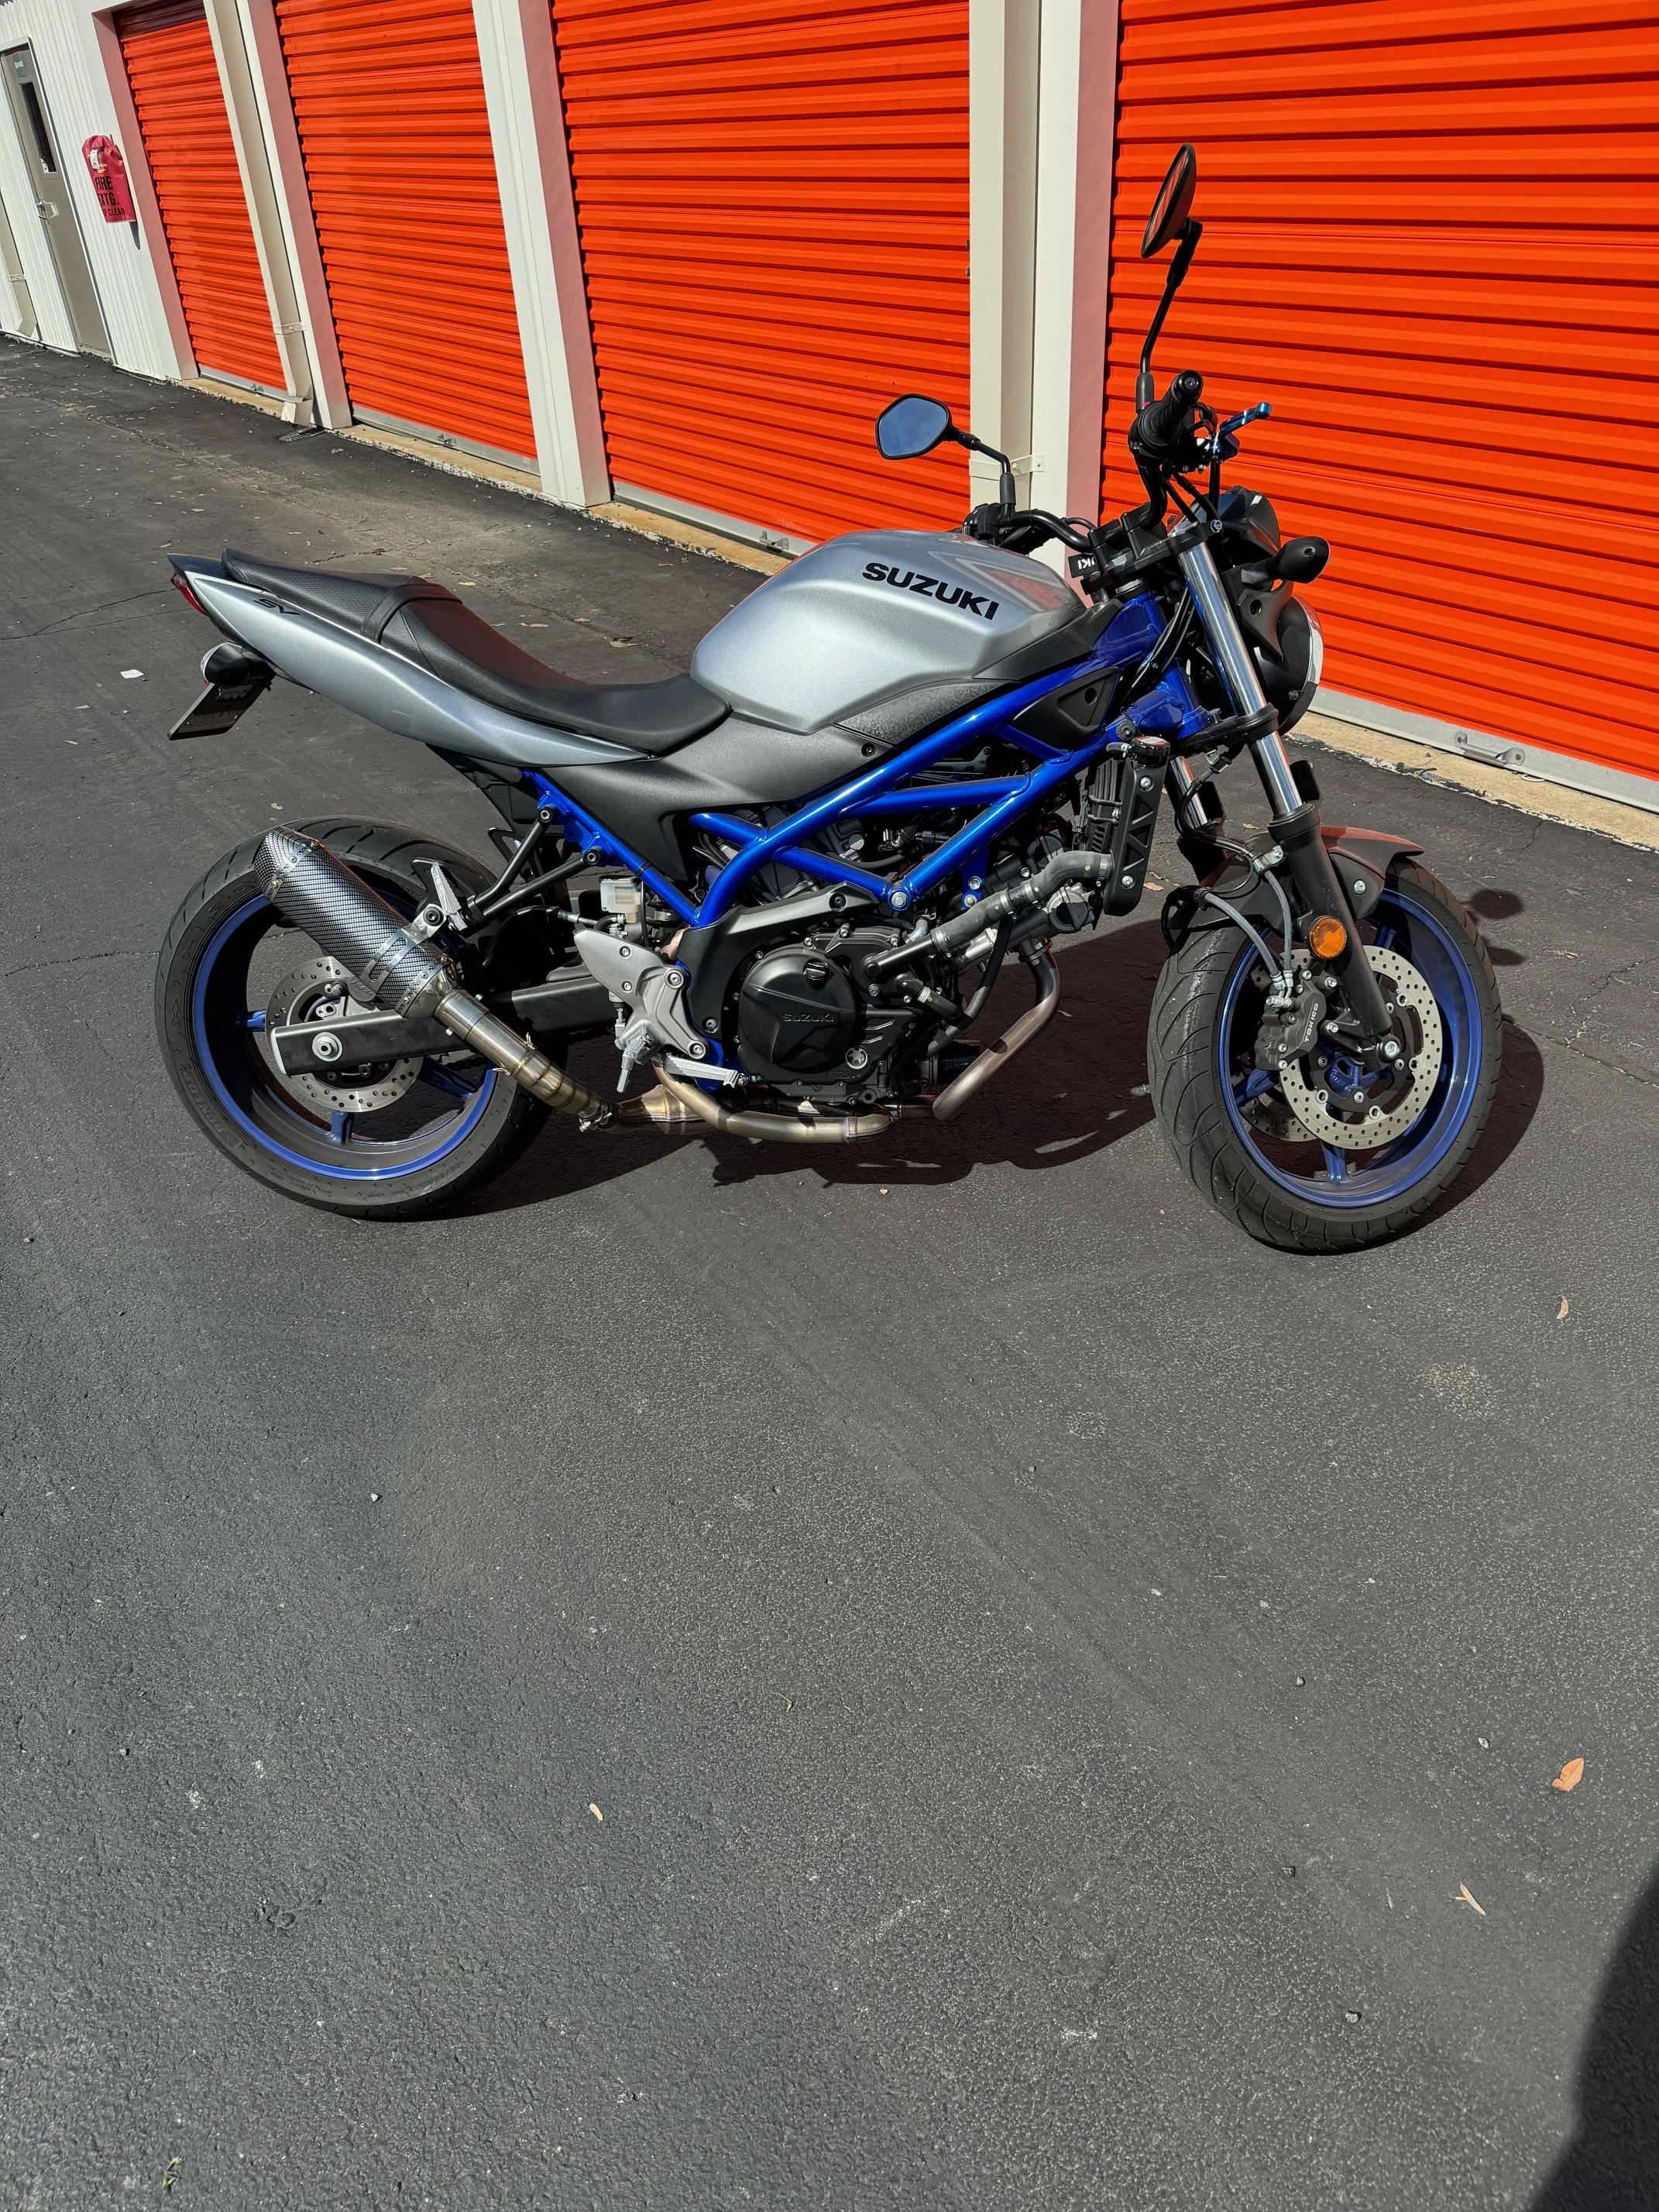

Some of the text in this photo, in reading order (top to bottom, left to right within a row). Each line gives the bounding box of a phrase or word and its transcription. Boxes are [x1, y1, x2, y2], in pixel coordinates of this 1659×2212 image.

[94, 175, 114, 191] FIRE
[108, 208, 125, 216] CLEAR
[861, 562, 1000, 621] SUZUKI
[252, 598, 302, 616] SV
[782, 1013, 834, 1022] SUZUKI
[1304, 1002, 1319, 1042] TOKICO
